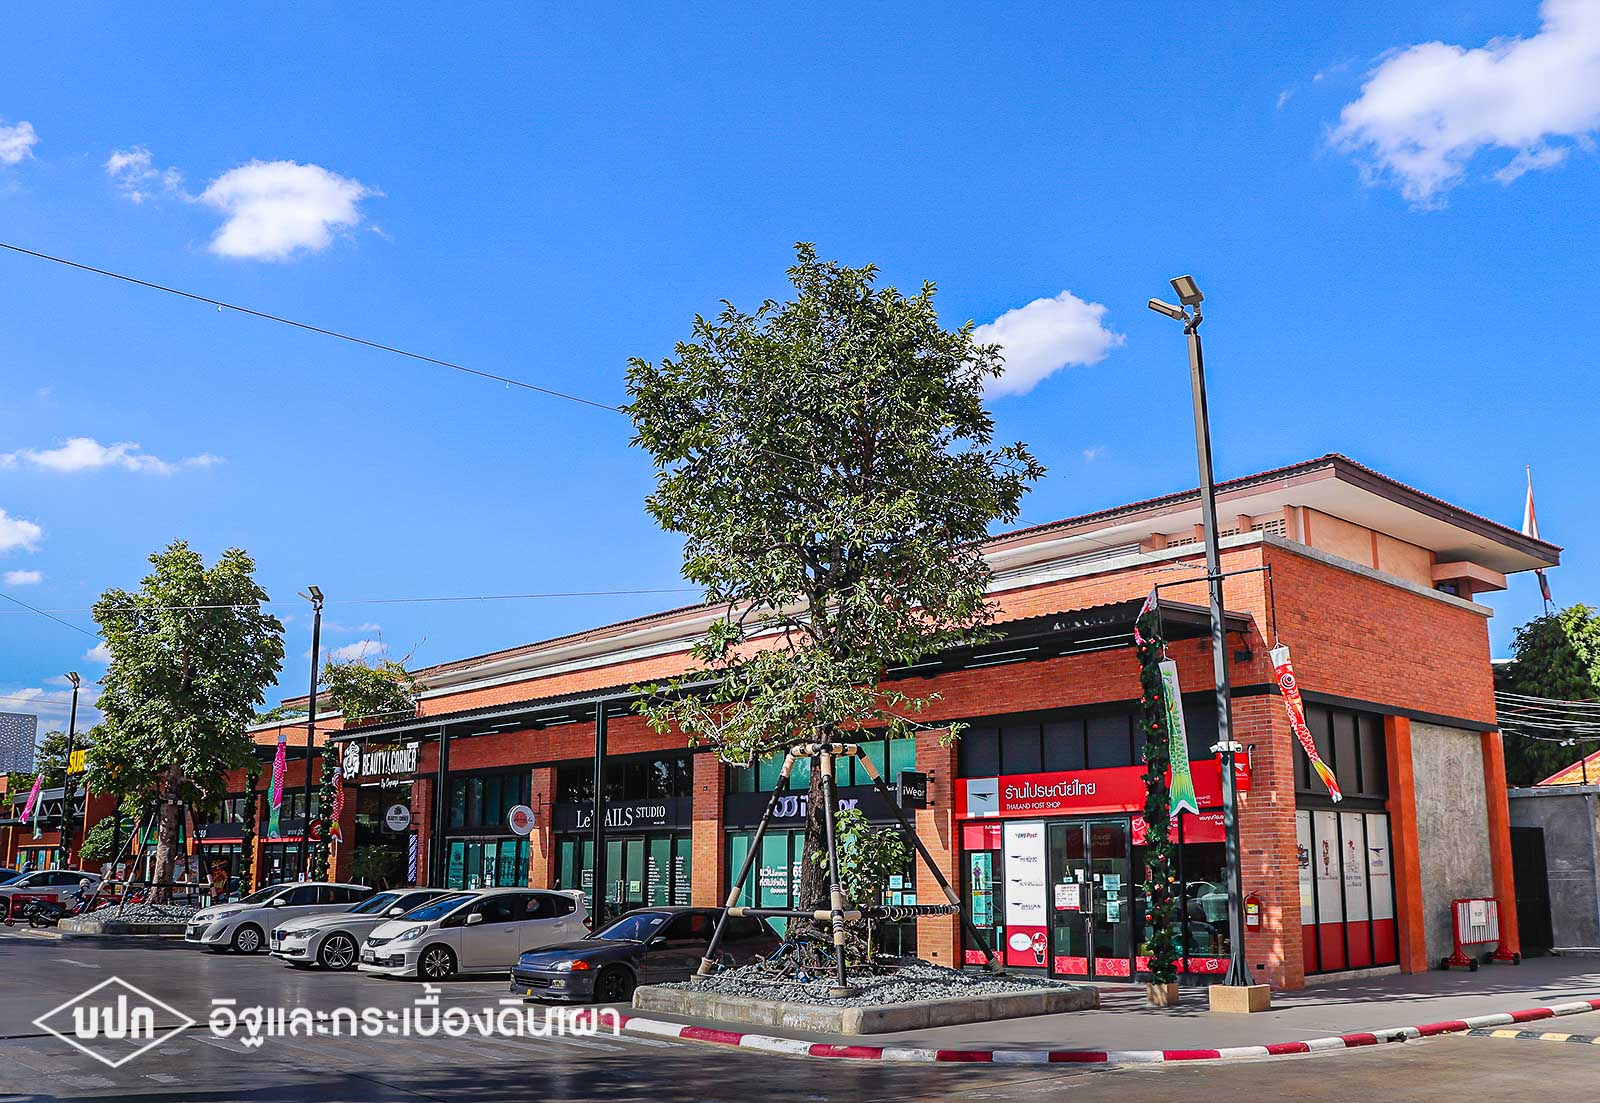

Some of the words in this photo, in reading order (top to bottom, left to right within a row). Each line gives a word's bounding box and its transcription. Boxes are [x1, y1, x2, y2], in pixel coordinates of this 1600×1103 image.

[67, 749, 87, 775] SUB
[362, 751, 386, 776] BEAUTY
[391, 750, 417, 773] CORNER
[903, 786, 925, 797] iWear
[1005, 779, 1096, 800] ร้านไปรษณีย์ไทย
[635, 805, 666, 818] STUDIO
[1032, 801, 1045, 809] POST
[1046, 801, 1061, 809] SHOP
